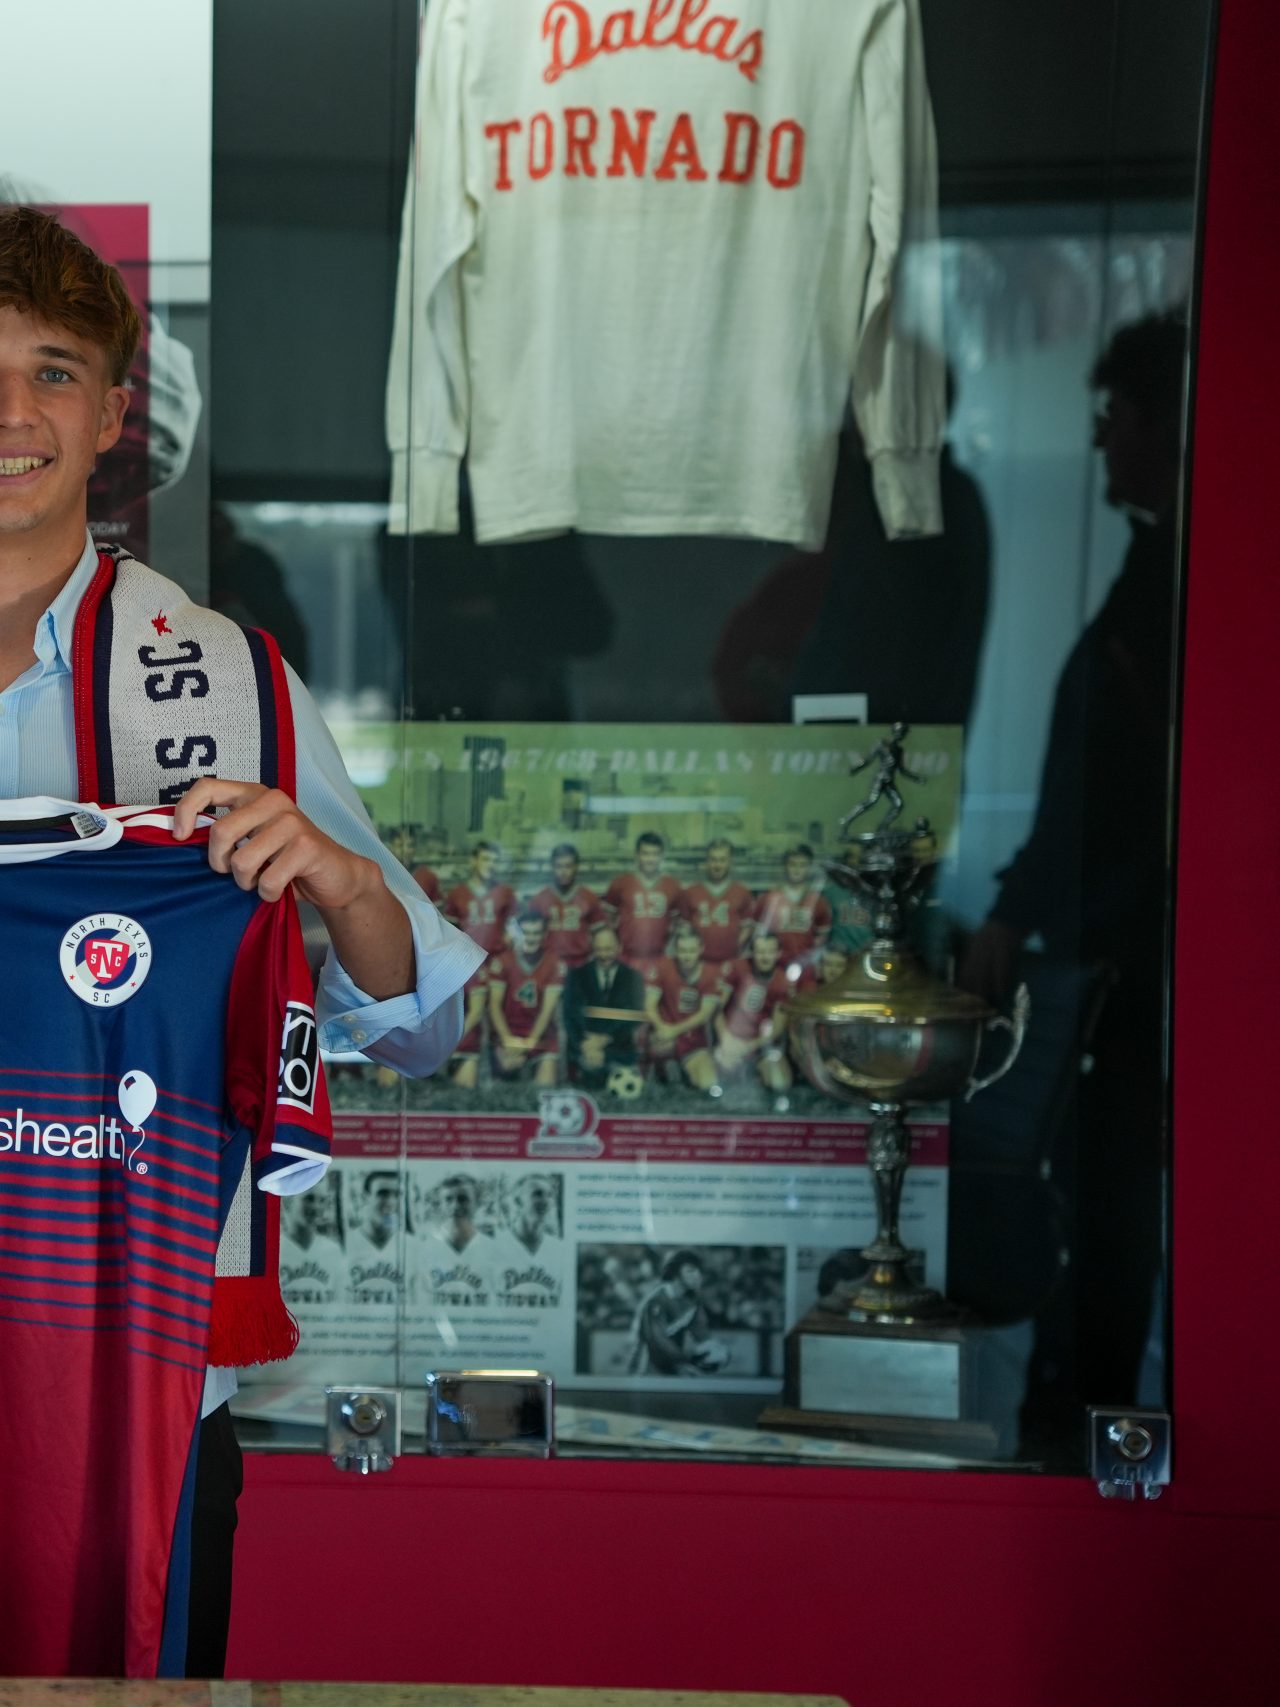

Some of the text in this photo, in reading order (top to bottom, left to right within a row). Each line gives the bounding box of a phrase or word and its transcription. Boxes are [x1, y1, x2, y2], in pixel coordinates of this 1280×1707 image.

[541, 0, 763, 84] Dallas
[484, 107, 805, 190] TORNADO
[137, 640, 210, 702] SC
[66, 917, 149, 958] NORTH TEXAS
[699, 901, 729, 927] 14
[93, 991, 110, 1003] SC
